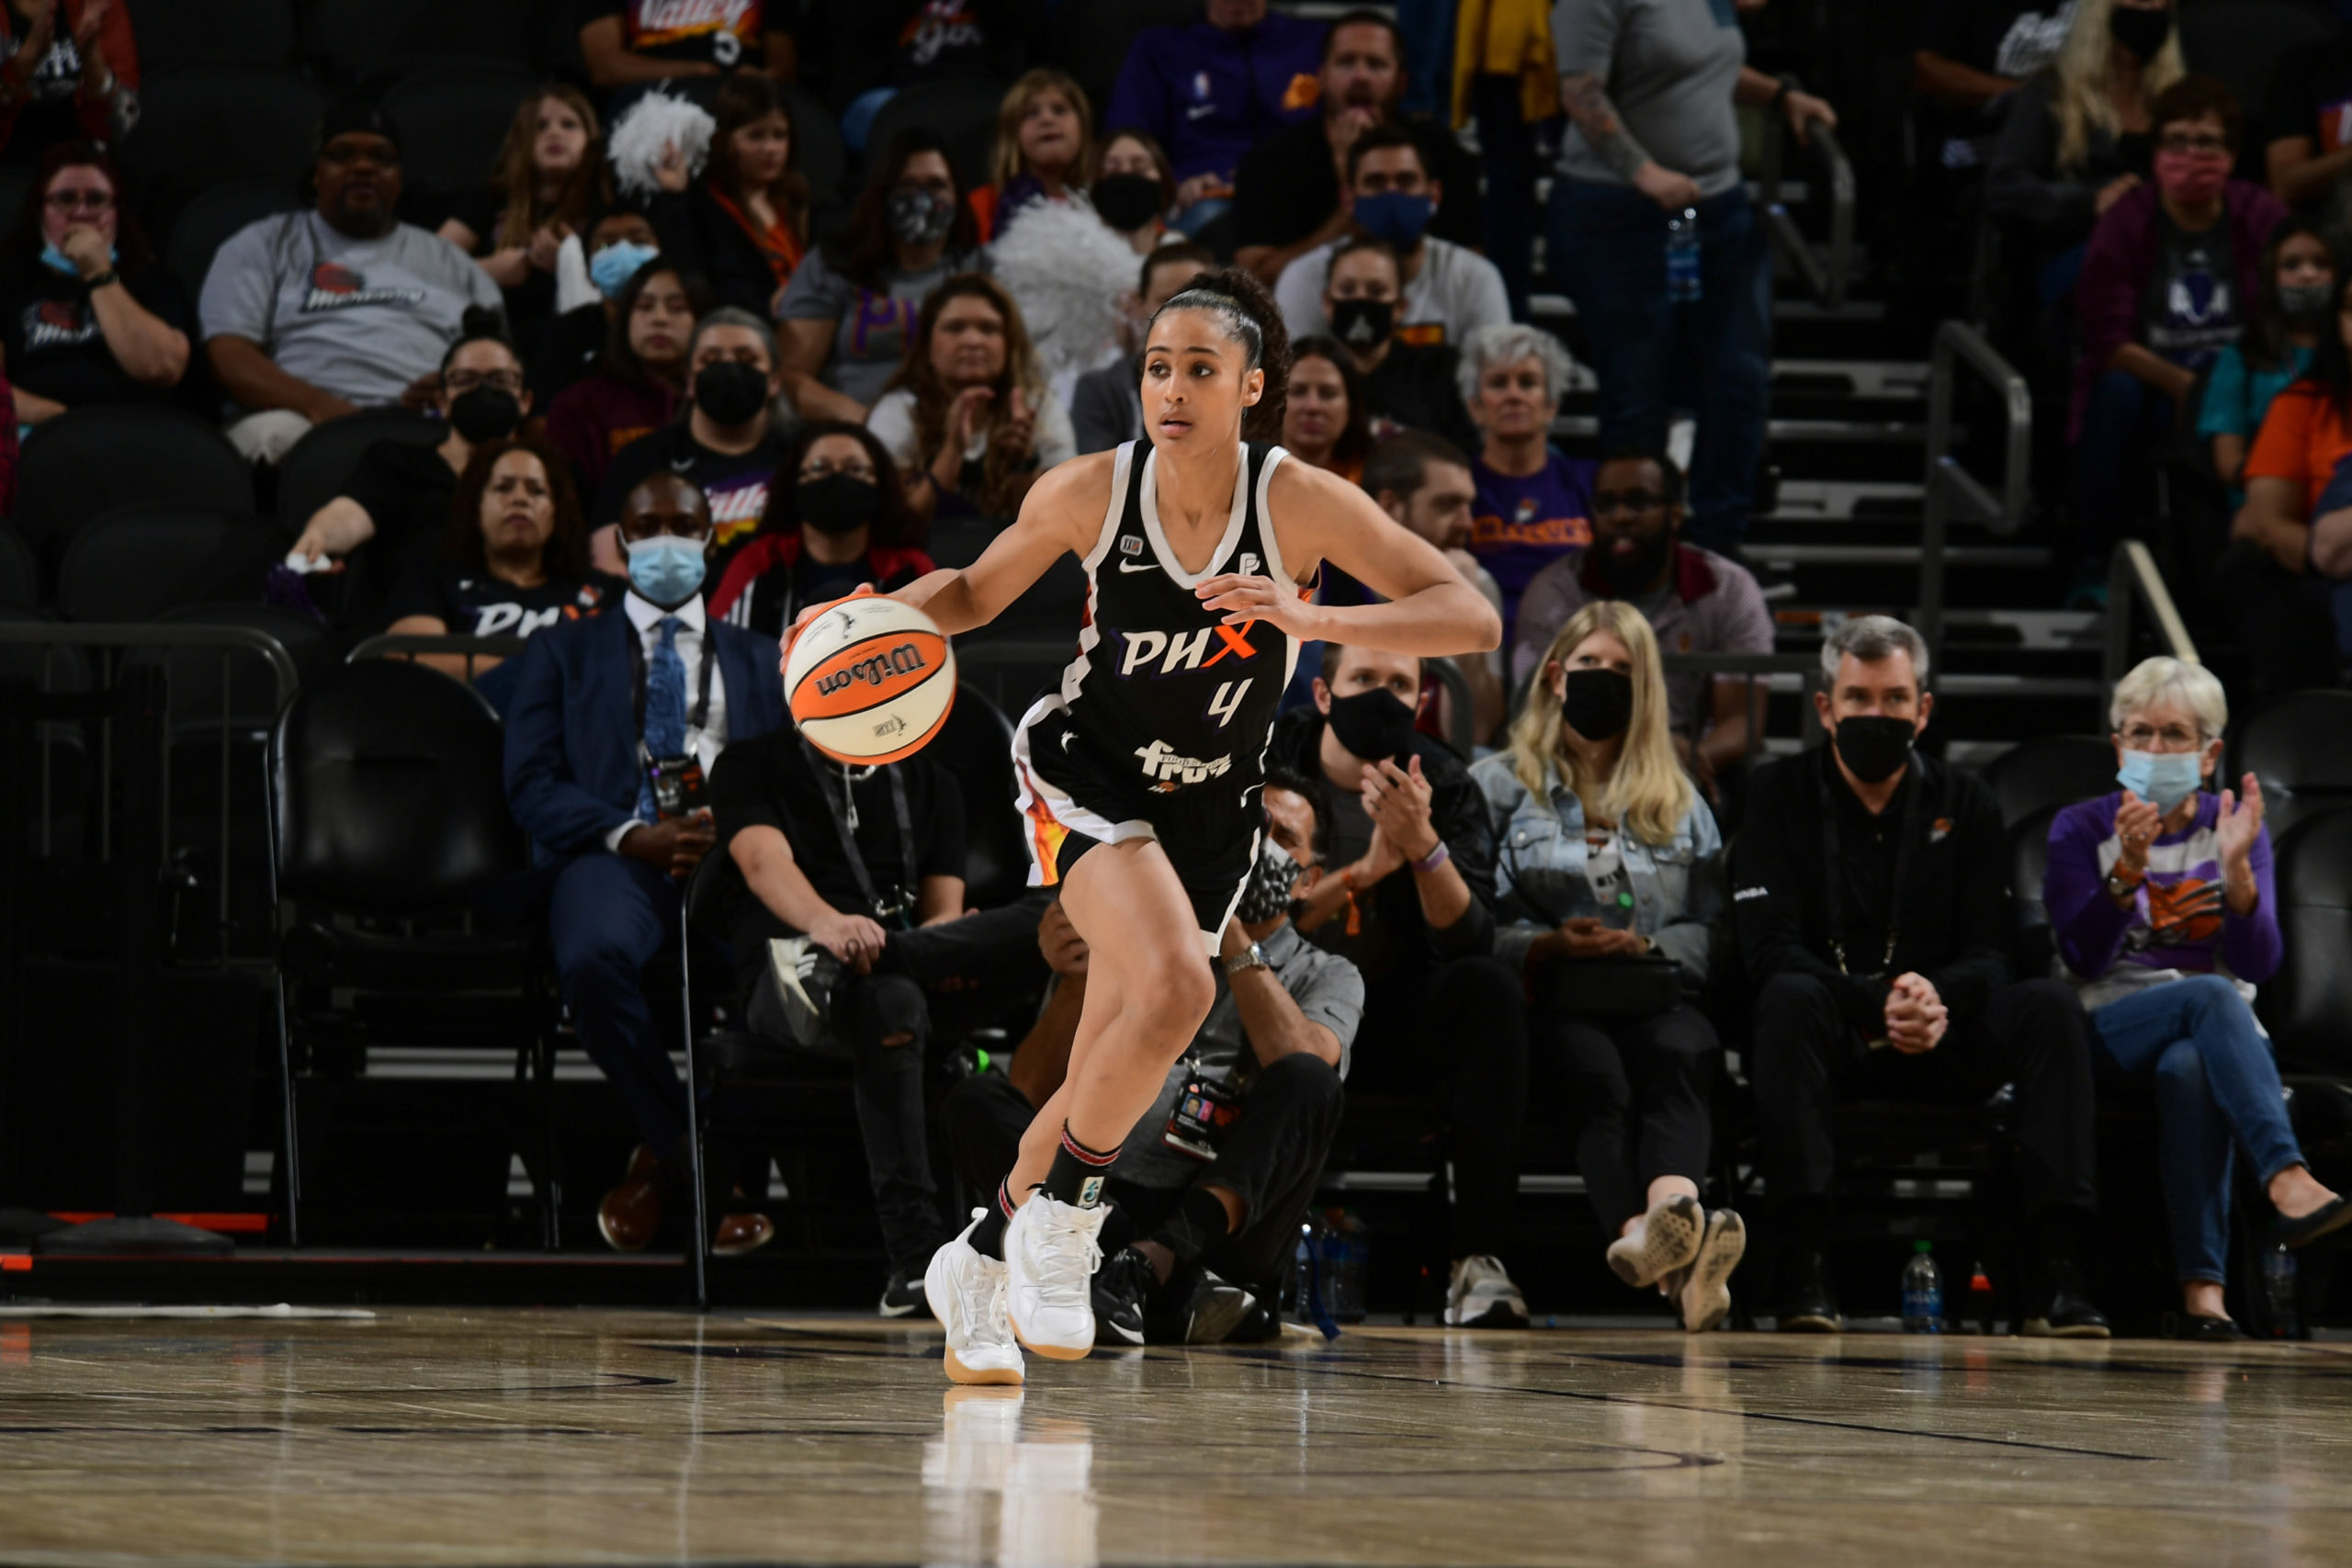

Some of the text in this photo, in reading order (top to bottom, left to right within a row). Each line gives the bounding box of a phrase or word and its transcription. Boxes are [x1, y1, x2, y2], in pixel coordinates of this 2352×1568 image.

[814, 642, 927, 698] Wilson
[1120, 618, 1259, 678] PHX
[1206, 677, 1254, 728] 4
